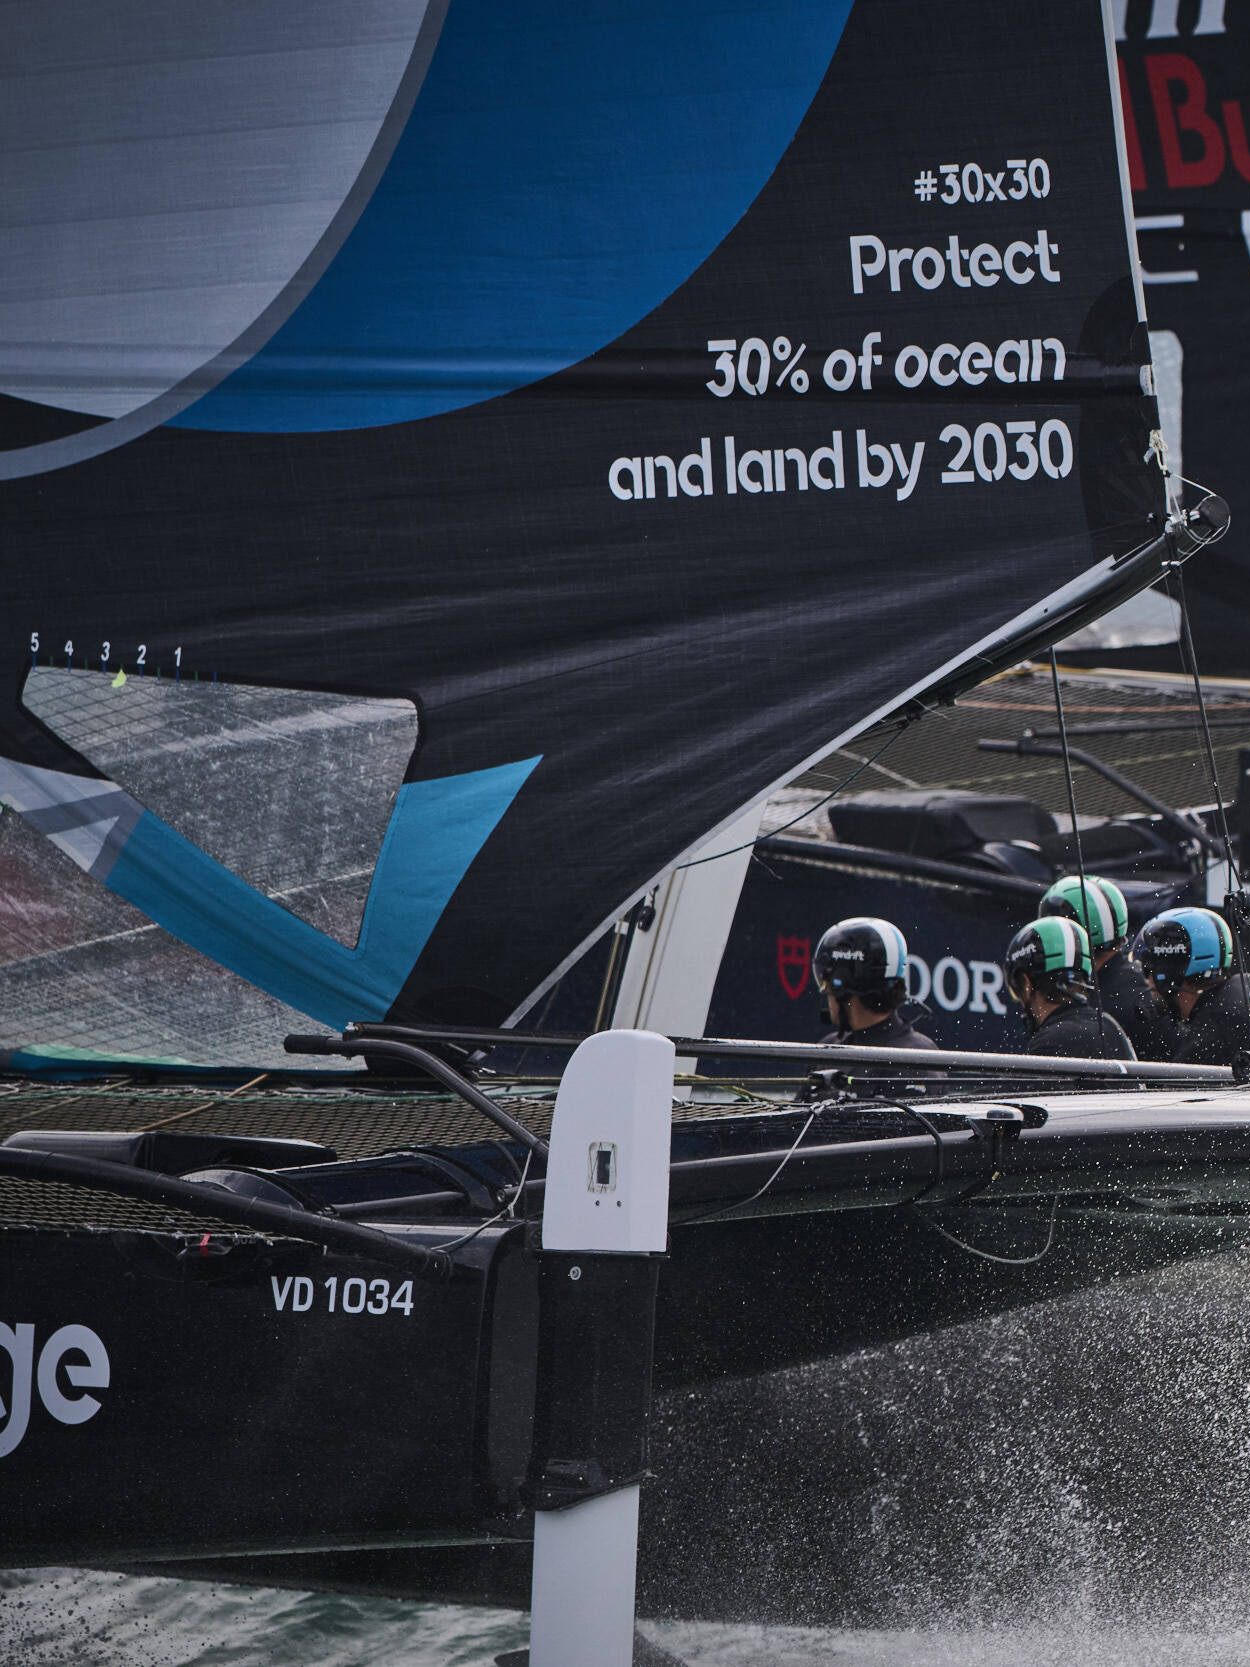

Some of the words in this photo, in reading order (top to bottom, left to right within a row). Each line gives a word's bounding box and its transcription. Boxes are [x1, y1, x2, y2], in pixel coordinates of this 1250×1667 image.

[914, 157, 1051, 205] #30x30
[849, 229, 1061, 294] Protect
[705, 335, 810, 398] 30%
[822, 331, 883, 391] of
[894, 337, 1067, 388] ocean
[608, 437, 714, 501] and
[724, 430, 845, 494] land
[856, 429, 926, 501] by
[938, 418, 1074, 484] 2030
[30, 632, 40, 652] 5
[64, 640, 74, 656] 4
[100, 641, 111, 662] 3
[136, 644, 146, 665] 2
[174, 646, 182, 667] 1
[904, 953, 1007, 1015] DOR
[271, 1276, 314, 1312] VD
[324, 1276, 414, 1316] 1034
